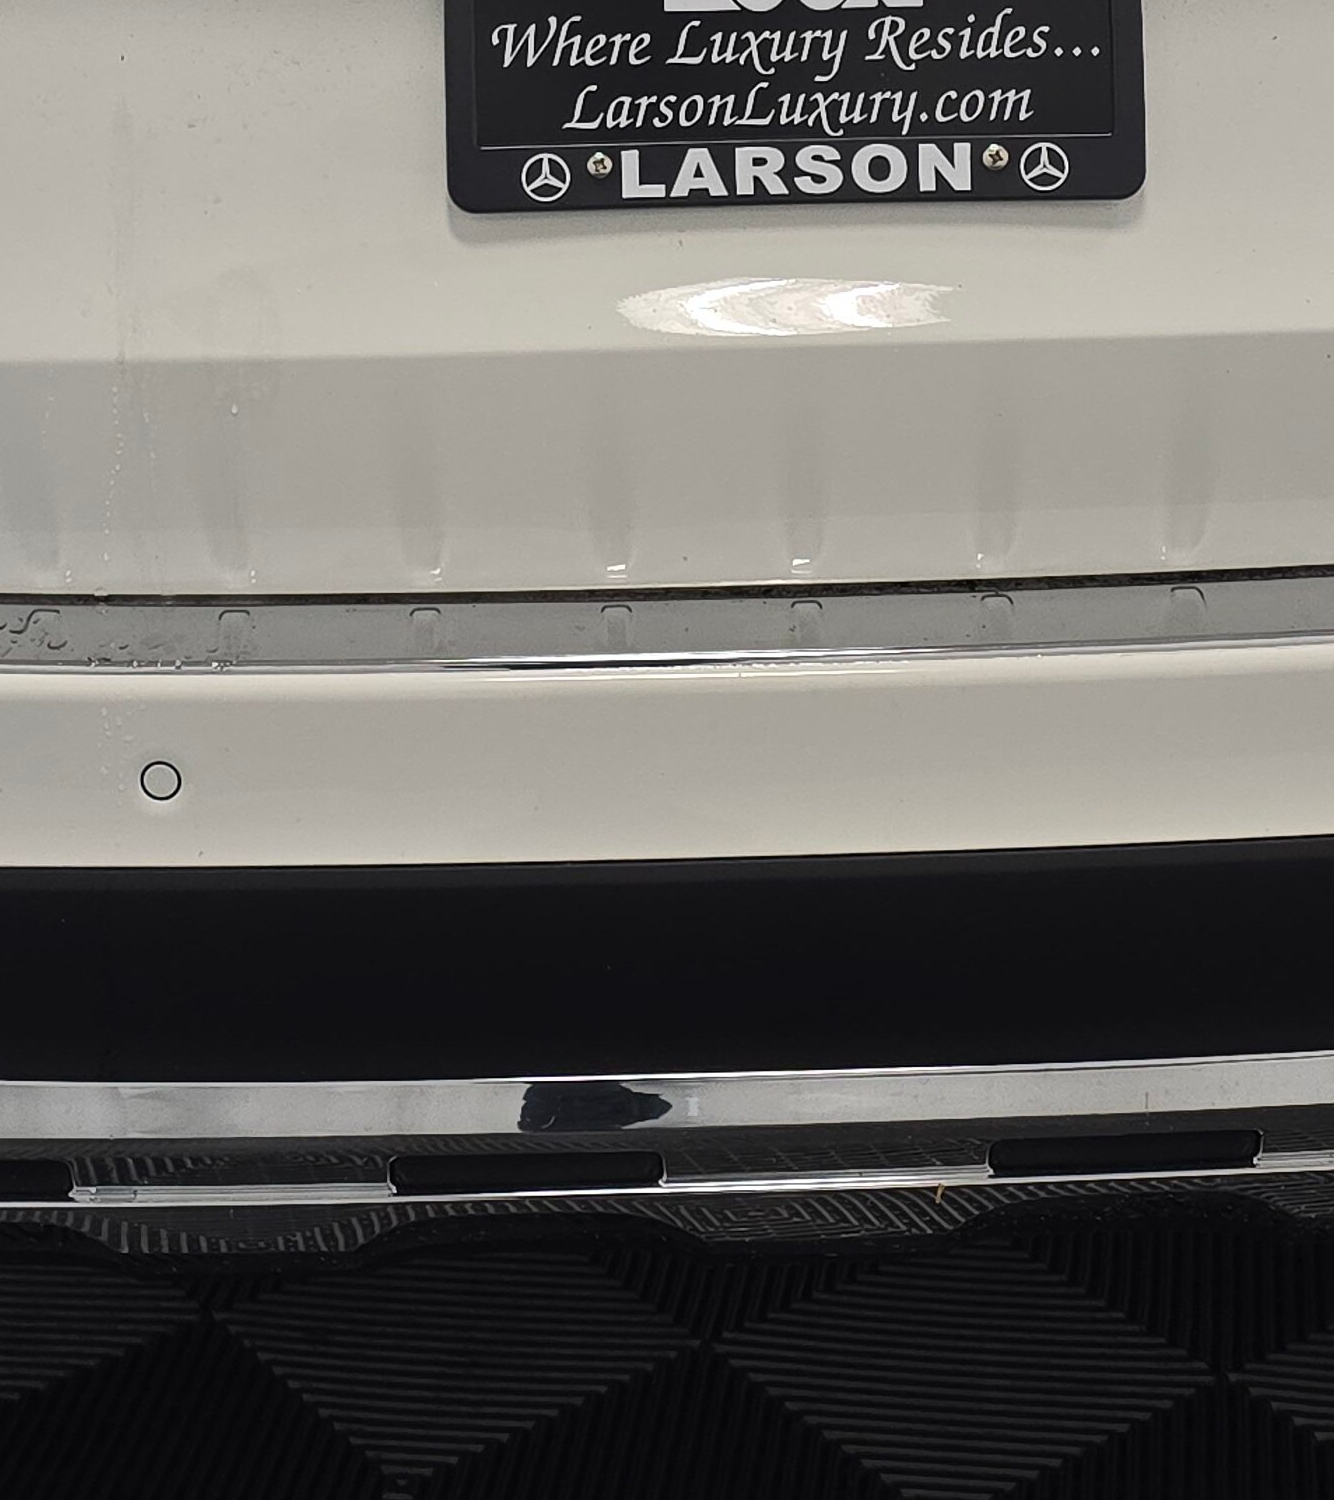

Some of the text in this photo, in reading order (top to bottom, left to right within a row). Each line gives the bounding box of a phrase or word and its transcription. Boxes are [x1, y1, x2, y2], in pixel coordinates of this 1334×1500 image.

[491, 8, 1101, 81] Where Luxury Resides...
[563, 80, 1035, 136] LarsonLuxury.com
[619, 142, 973, 199] LARSON
